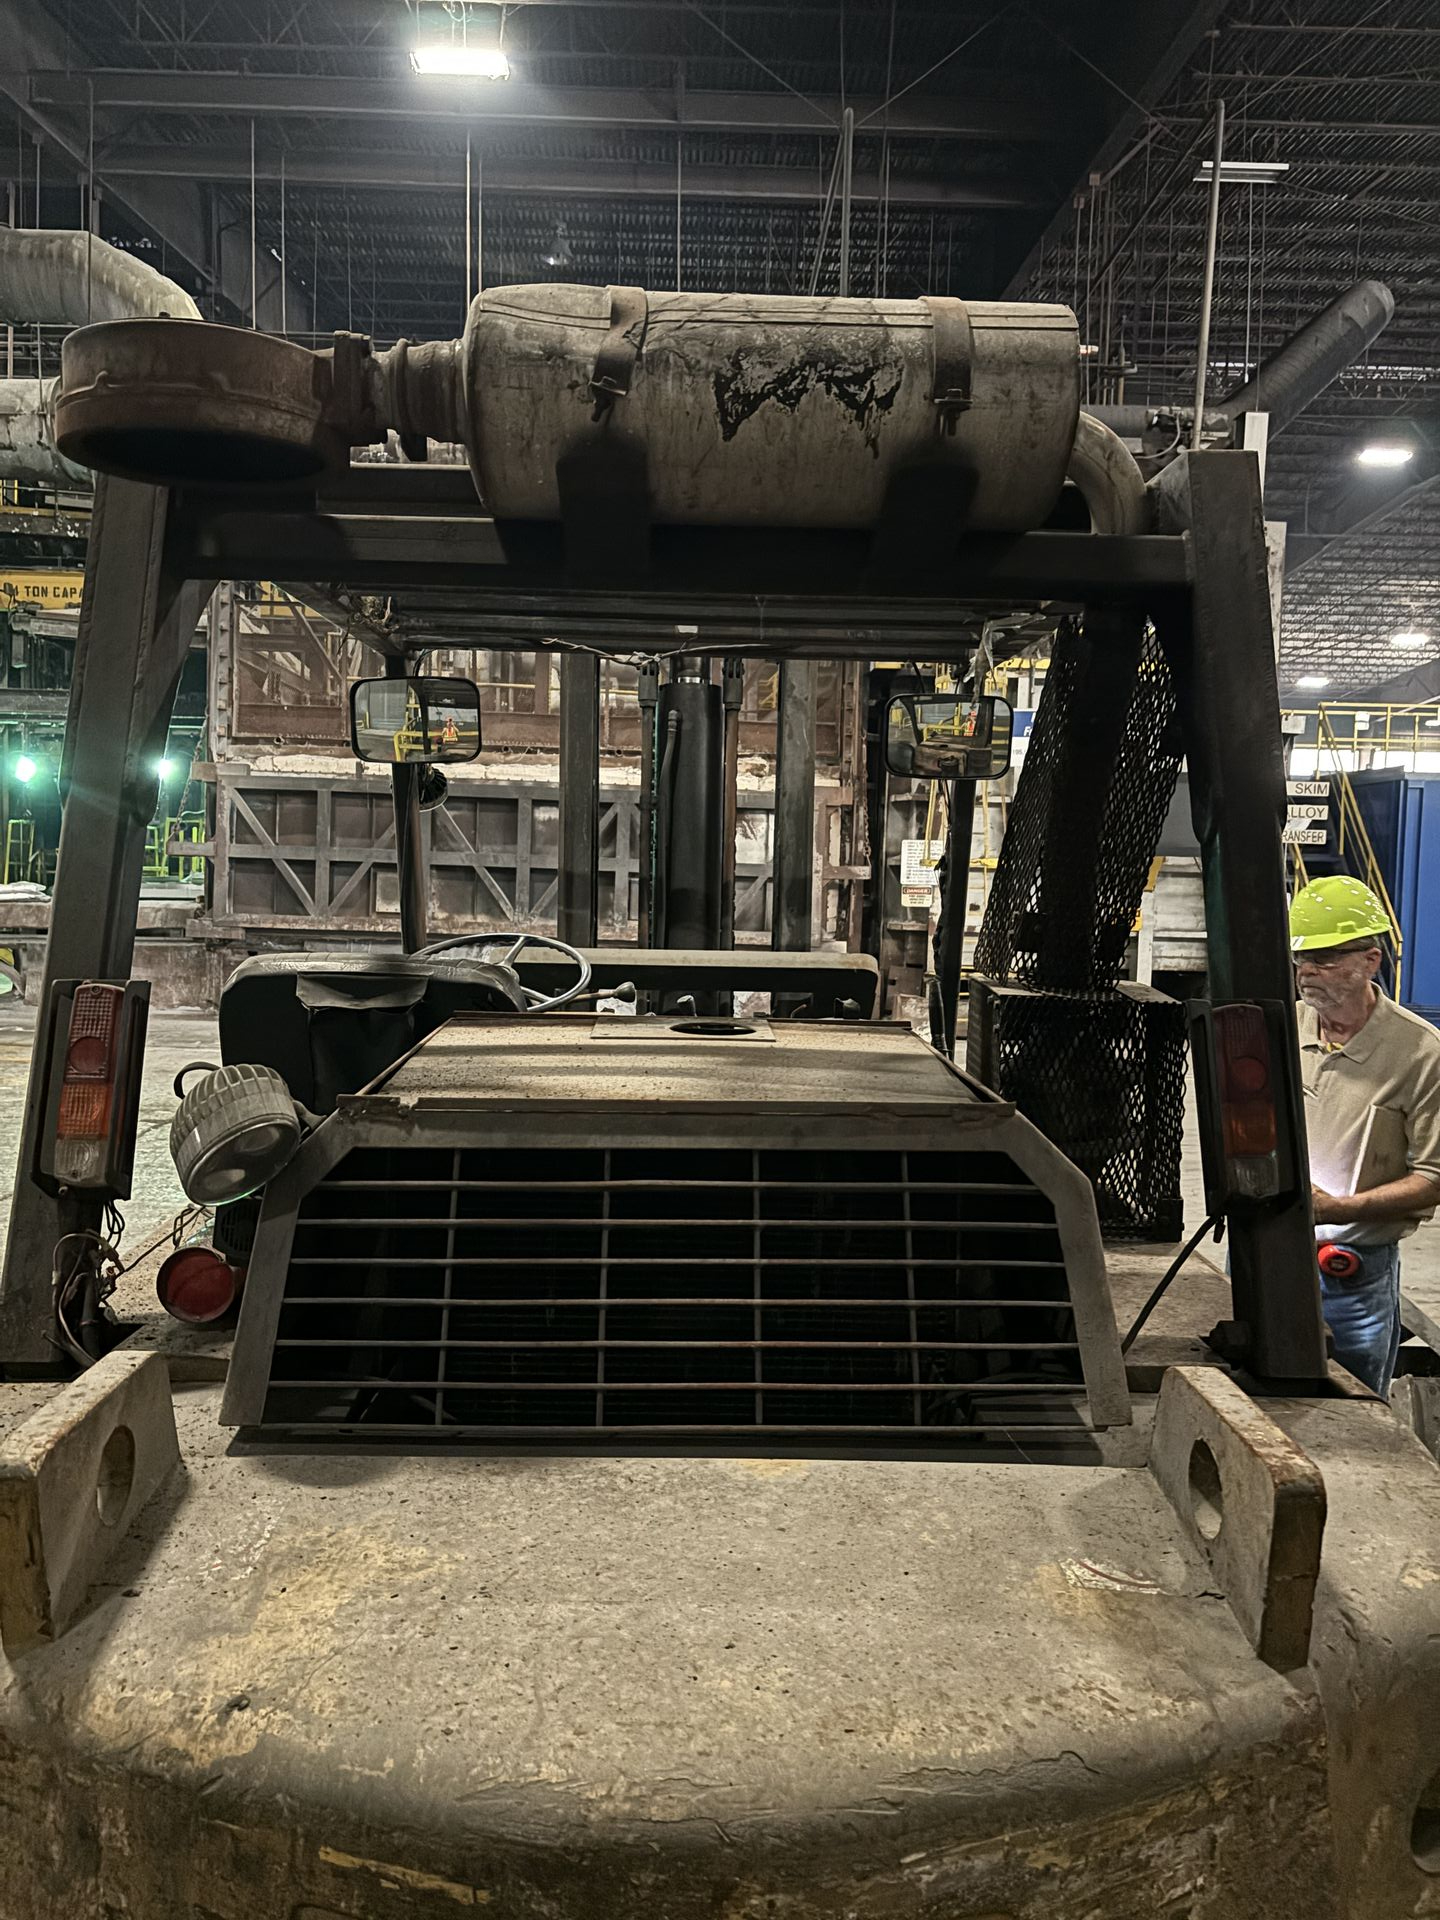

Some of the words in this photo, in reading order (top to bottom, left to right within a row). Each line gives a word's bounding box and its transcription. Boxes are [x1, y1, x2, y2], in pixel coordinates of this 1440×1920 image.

[24, 585, 48, 597] TON
[1295, 783, 1327, 794] SKIM
[1289, 807, 1325, 818] LLOY
[1282, 830, 1324, 842] RANSFER
